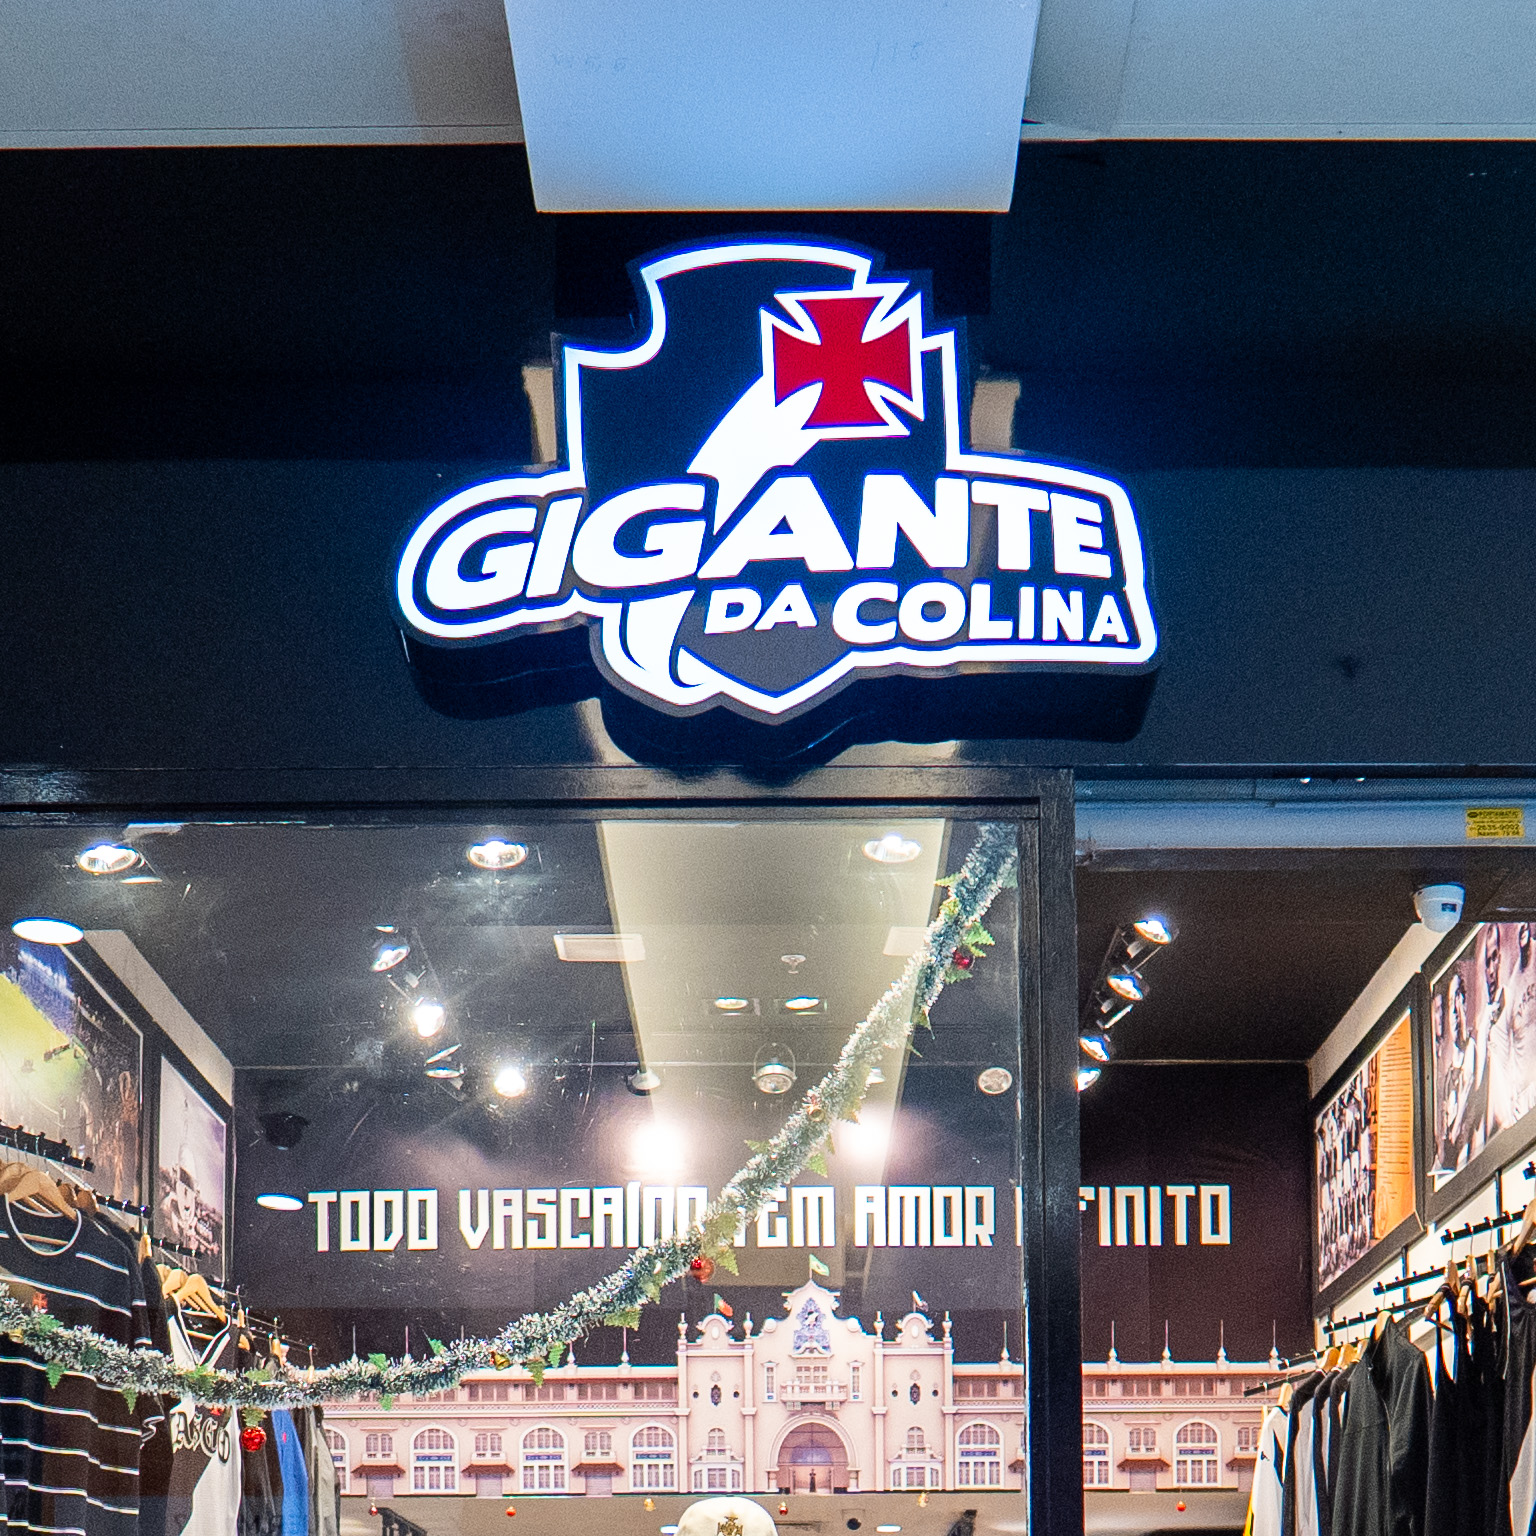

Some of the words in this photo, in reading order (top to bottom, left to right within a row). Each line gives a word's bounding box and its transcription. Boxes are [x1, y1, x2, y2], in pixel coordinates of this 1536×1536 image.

[426, 474, 1114, 610] GIGANTE
[704, 586, 819, 635] DA
[832, 581, 1131, 644] COLINA
[307, 1188, 440, 1253] TODO
[458, 1181, 709, 1250] VASCAÍNO
[730, 1185, 836, 1248] EM
[854, 1185, 995, 1248] AMOR
